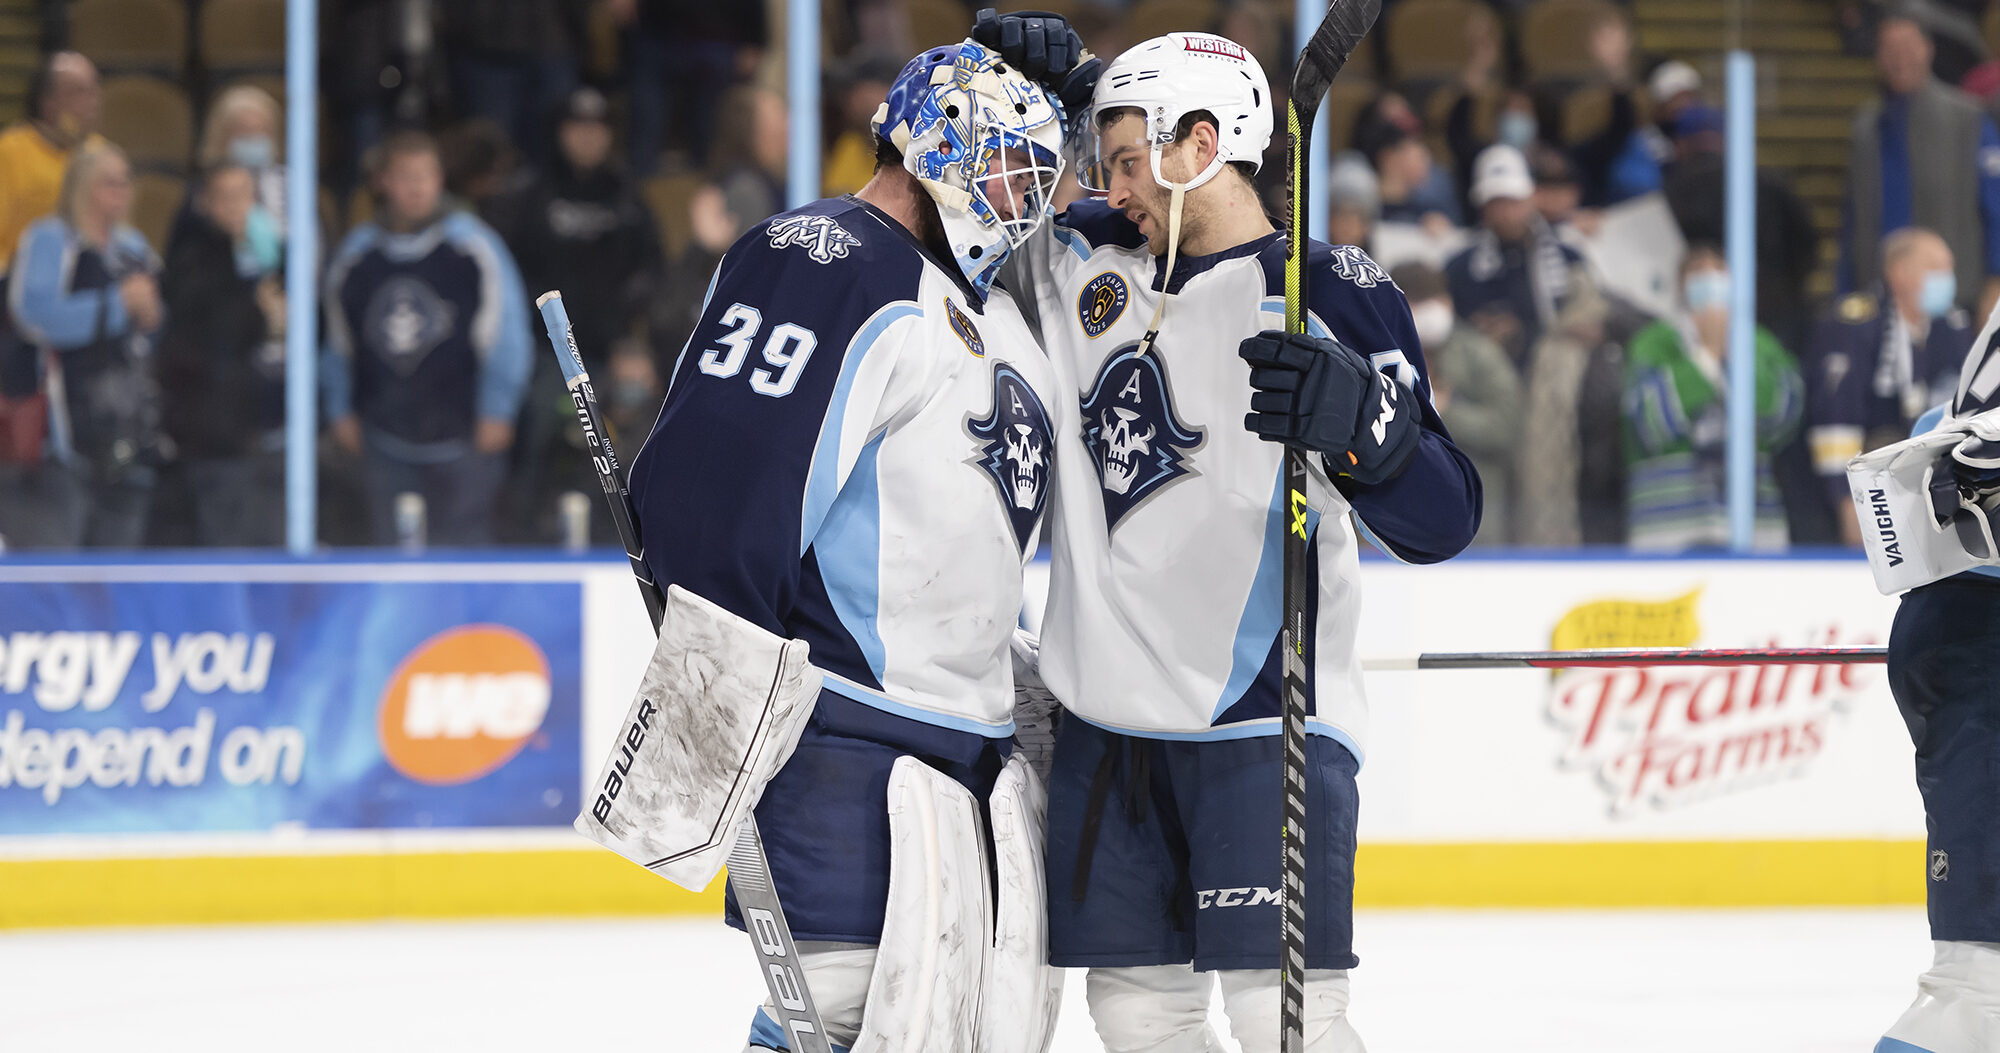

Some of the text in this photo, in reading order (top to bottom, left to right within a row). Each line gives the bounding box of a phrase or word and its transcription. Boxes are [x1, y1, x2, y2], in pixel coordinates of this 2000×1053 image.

[1187, 37, 1242, 58] WESTERN
[697, 302, 819, 399] 39
[1008, 384, 1028, 418] A
[1118, 368, 1142, 404] A
[602, 437, 620, 470] INGRAM
[1868, 488, 1905, 568] VAUGHN
[0, 630, 276, 713] rgy you
[219, 725, 306, 787] on
[1610, 722, 1824, 799] Farms
[1197, 886, 1283, 910] CCM
